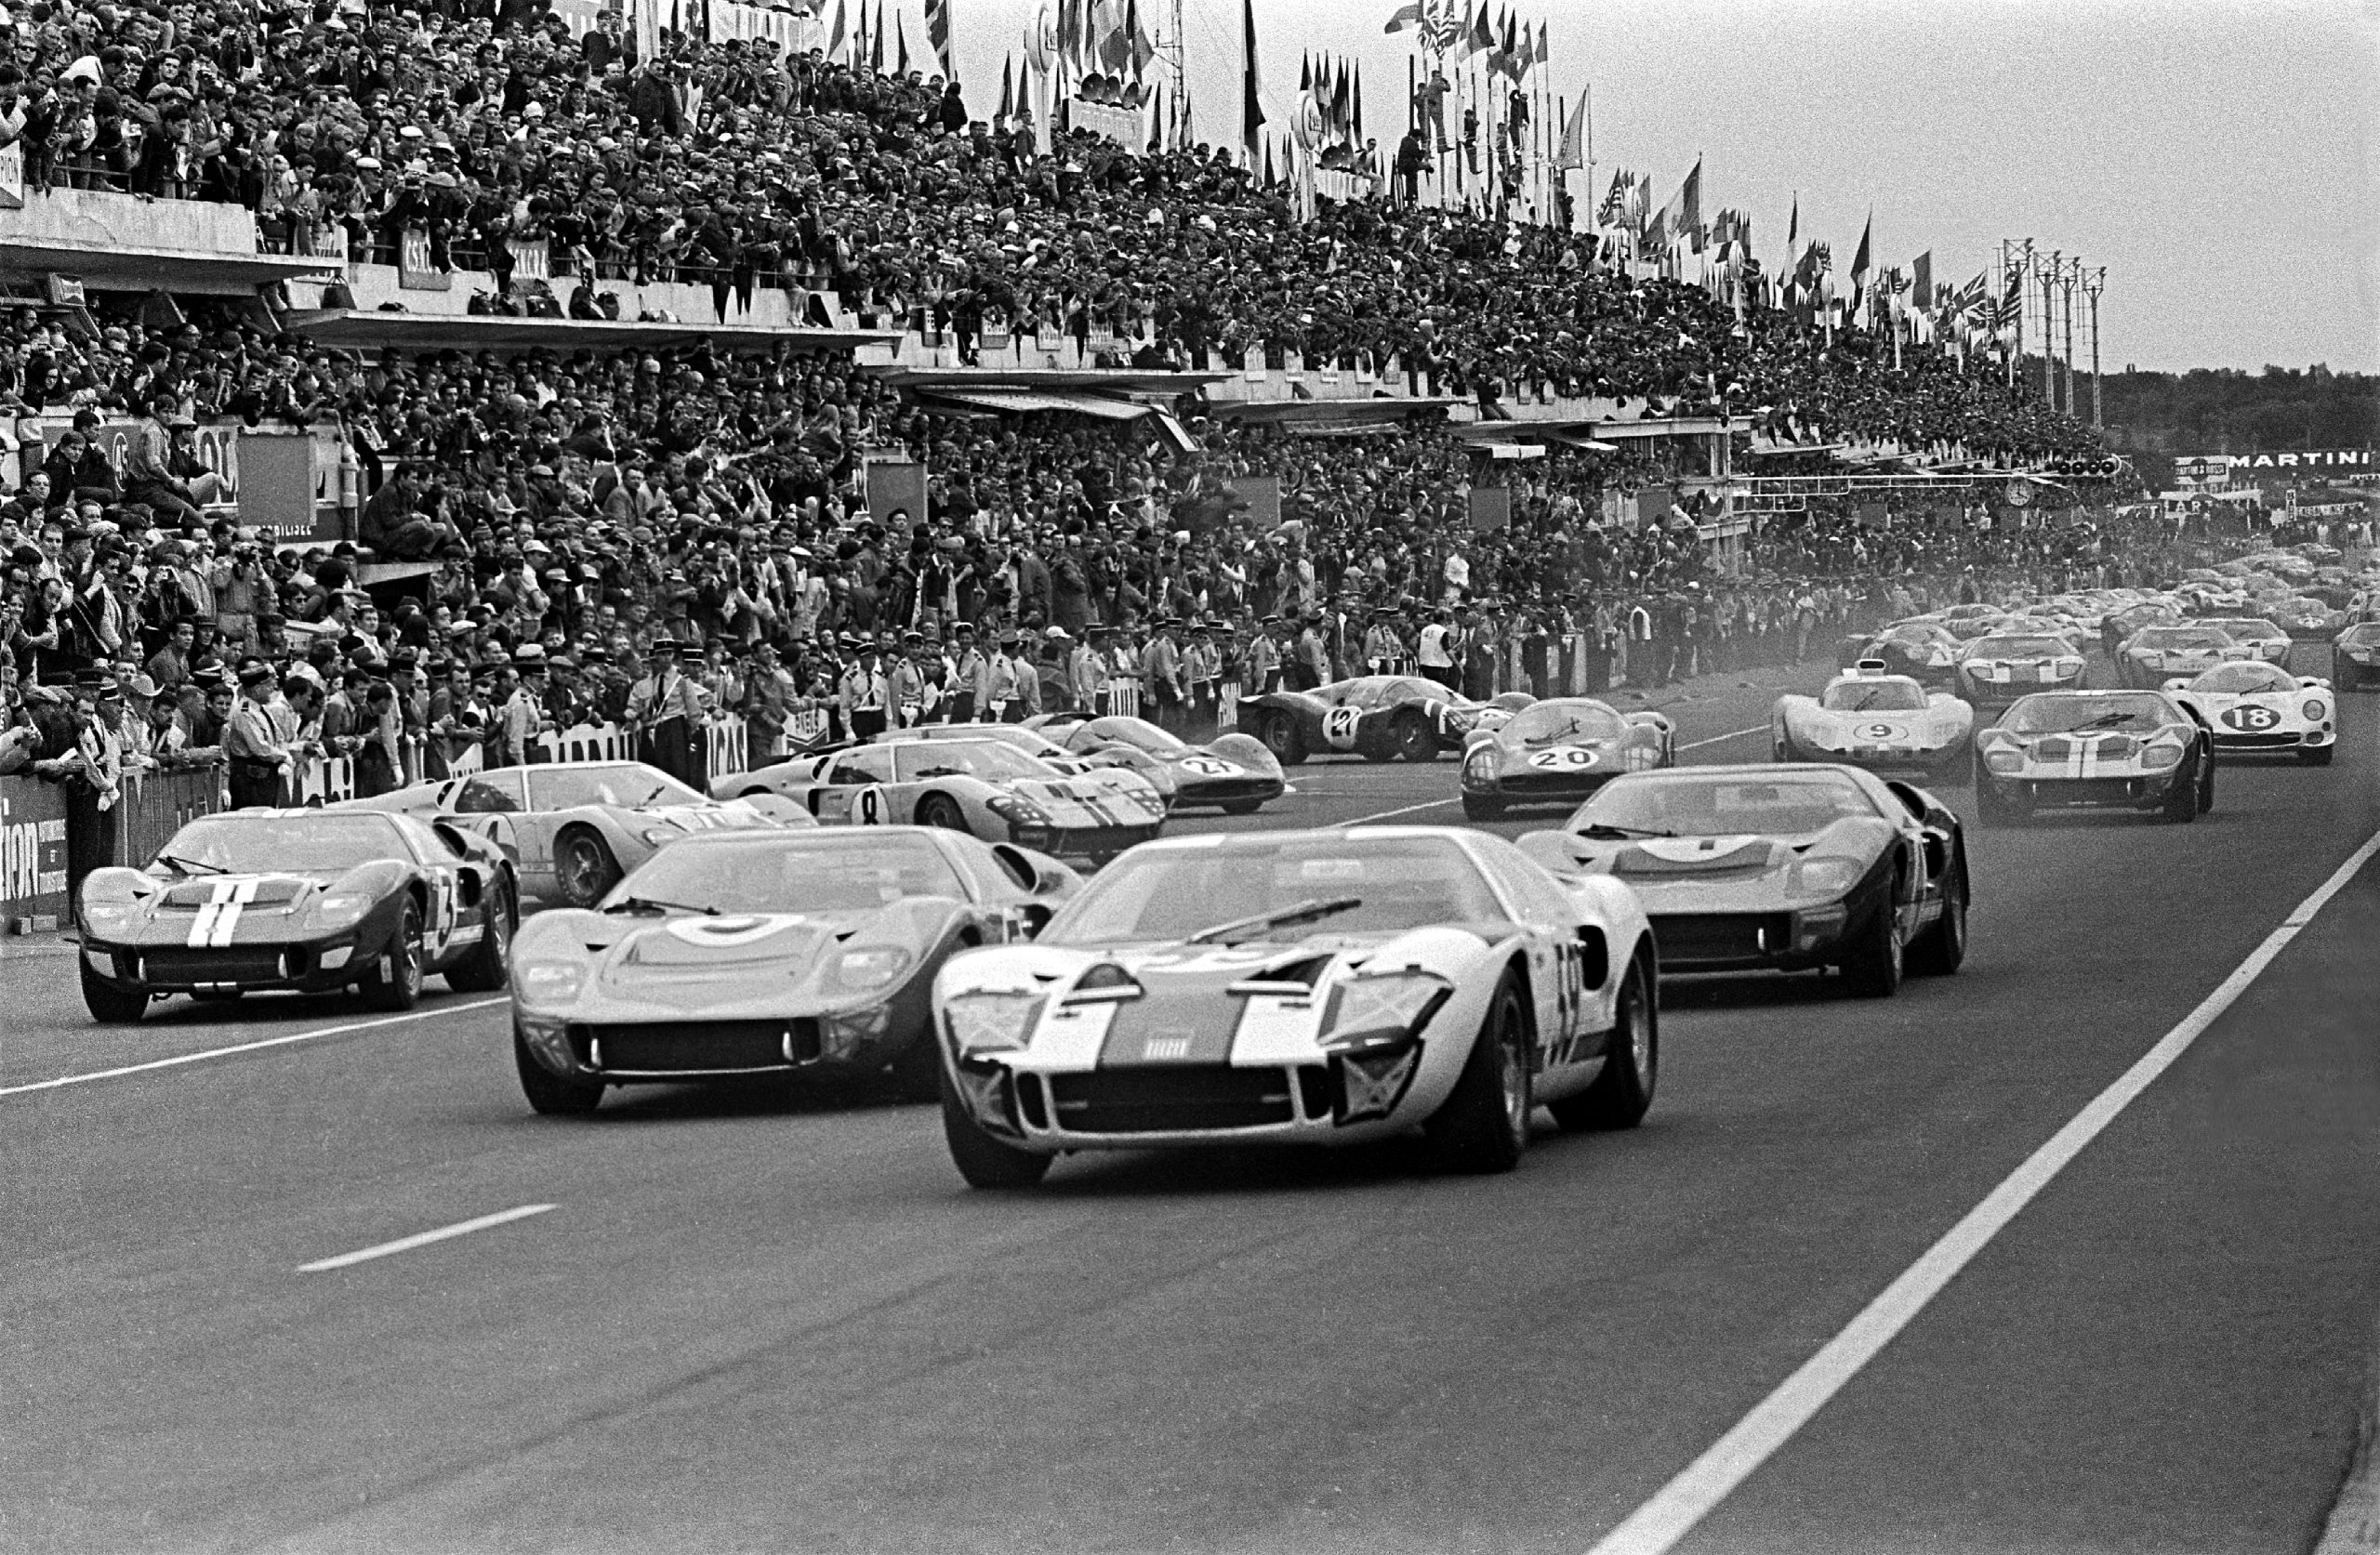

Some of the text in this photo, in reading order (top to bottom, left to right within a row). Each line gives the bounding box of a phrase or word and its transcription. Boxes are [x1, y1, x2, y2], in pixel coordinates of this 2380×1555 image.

[2229, 452, 2369, 468] MARTINI
[2233, 708, 2272, 728] 18
[1870, 724, 1891, 737] 9
[1536, 750, 1592, 767] 20
